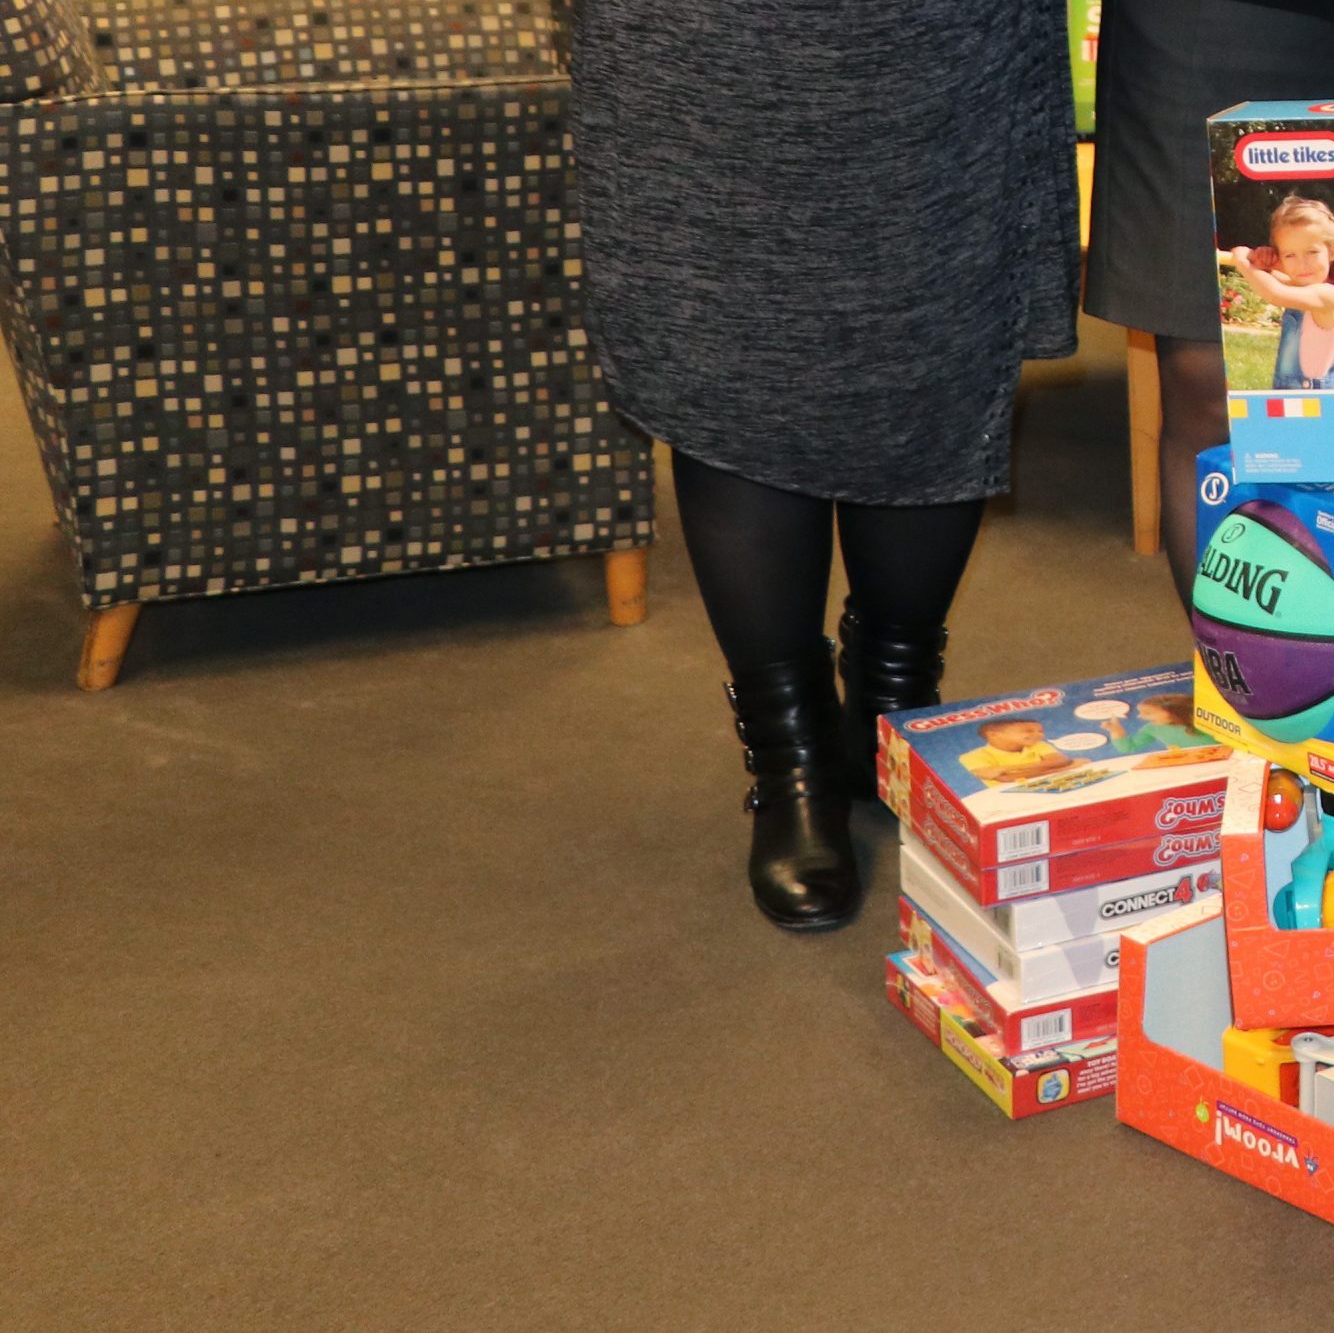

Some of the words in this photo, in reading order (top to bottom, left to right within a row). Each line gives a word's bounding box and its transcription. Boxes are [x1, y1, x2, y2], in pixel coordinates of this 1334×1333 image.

[1248, 147, 1290, 165] little
[907, 708, 989, 732] Guess
[988, 689, 1064, 715] Who?
[1195, 706, 1241, 737] OUTDOOR
[1160, 797, 1216, 827] Who?
[1157, 833, 1215, 864] Who?
[1101, 891, 1174, 918] CONNECT
[1173, 875, 1194, 903] 4
[1214, 1109, 1301, 1170] vroom!
